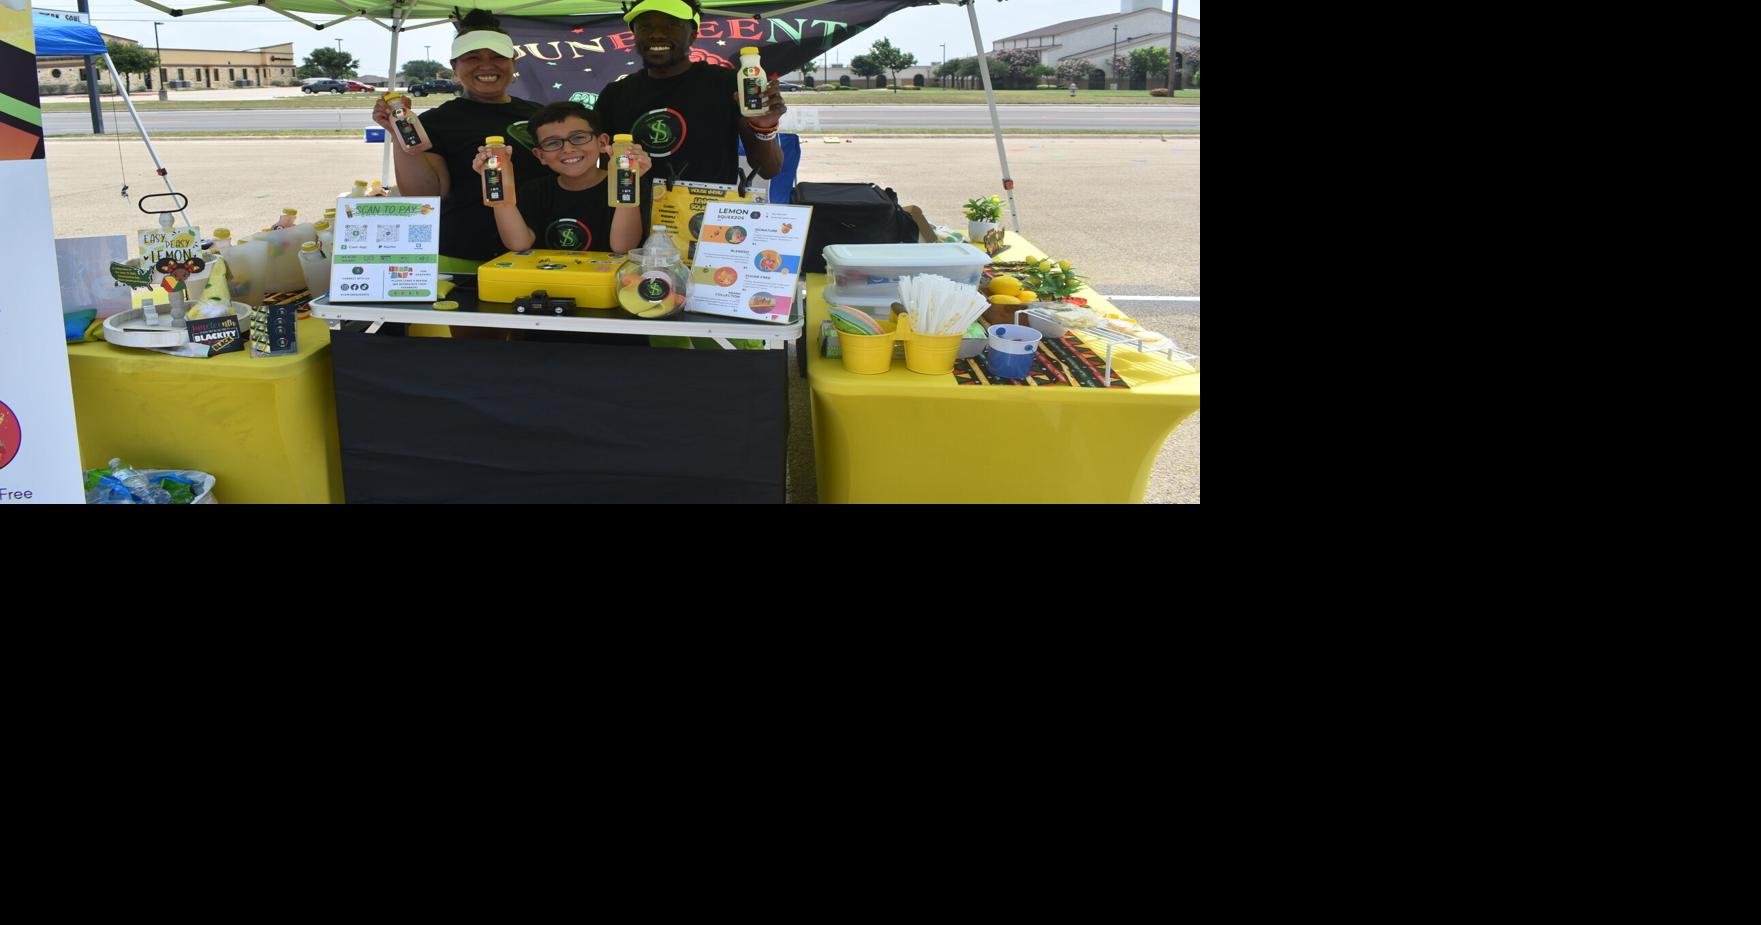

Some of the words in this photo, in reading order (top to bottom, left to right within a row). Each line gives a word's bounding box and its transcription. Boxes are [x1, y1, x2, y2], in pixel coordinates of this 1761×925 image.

[65, 14, 81, 22] SOUL
[355, 205, 380, 215] SCAN
[384, 205, 396, 214] TO
[398, 205, 417, 214] PAY
[143, 233, 166, 244] EASY
[166, 239, 190, 249] PEASY
[151, 249, 192, 263] LEMON
[194, 330, 237, 343] BLACKITY
[0, 488, 33, 499] Free
